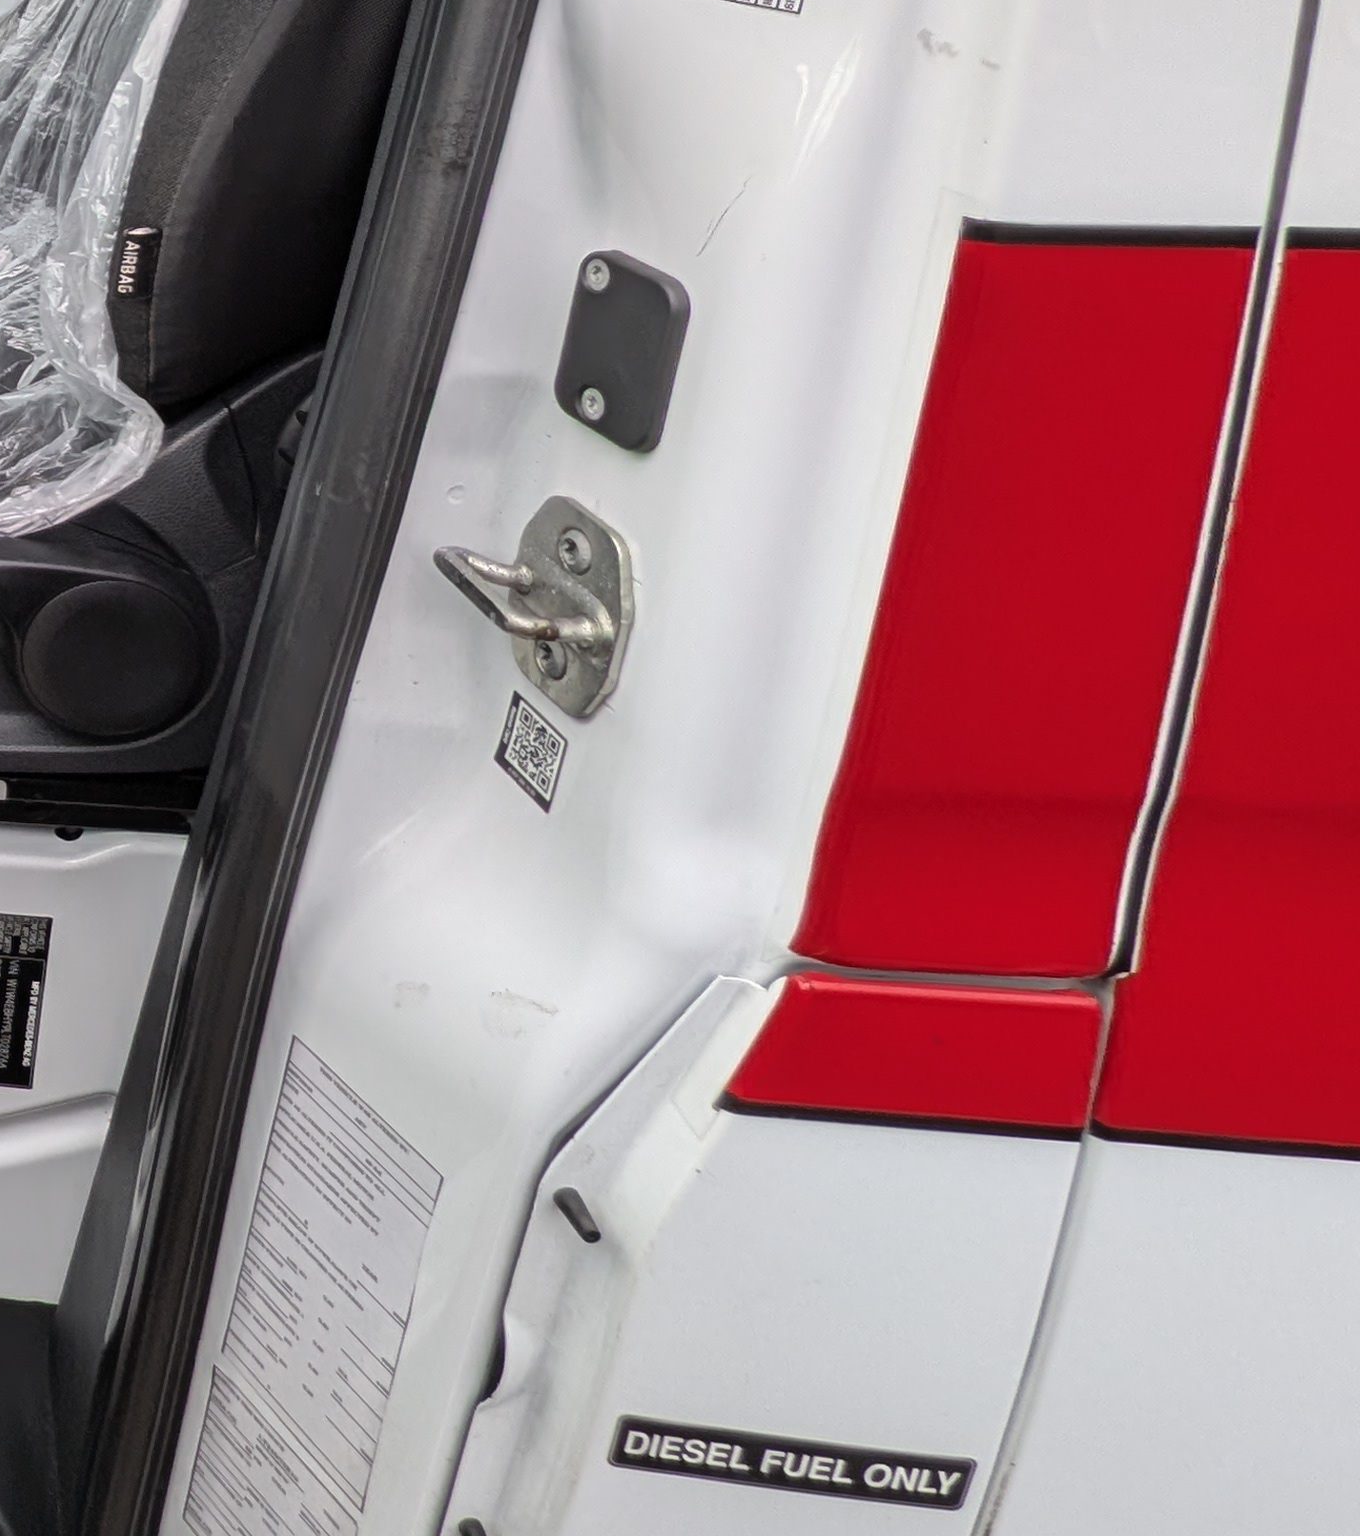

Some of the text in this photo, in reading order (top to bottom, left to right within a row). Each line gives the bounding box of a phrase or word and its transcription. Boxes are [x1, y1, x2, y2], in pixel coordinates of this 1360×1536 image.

[117, 240, 141, 294] AIRBAG
[7, 959, 19, 975] VIN
[21, 980, 39, 1066] MFD BY MERCEDES-BENZ AG
[624, 1431, 963, 1498] DIESEL FUEL ONLY
